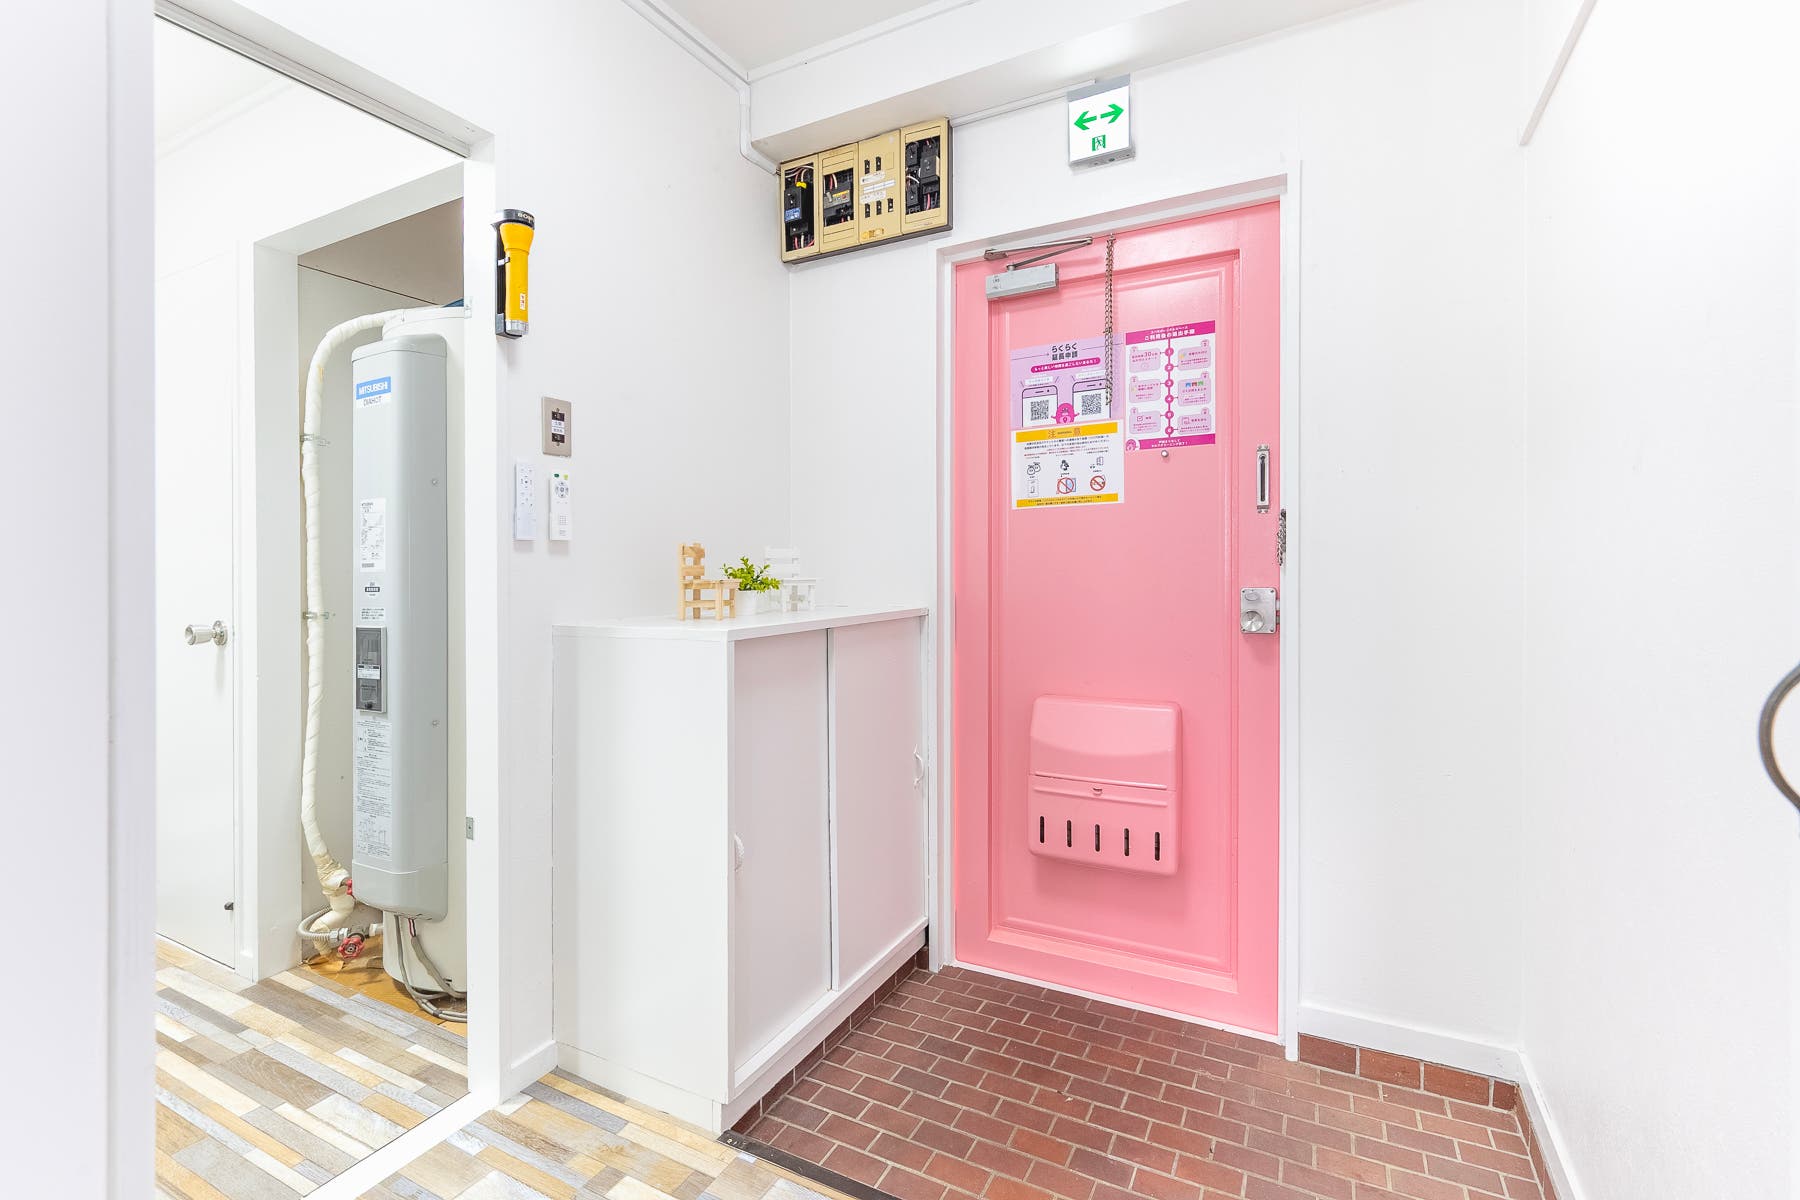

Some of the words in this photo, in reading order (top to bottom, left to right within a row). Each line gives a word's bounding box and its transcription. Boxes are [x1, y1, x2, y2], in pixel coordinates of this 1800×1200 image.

[1051, 342, 1078, 353] らくらく
[1051, 351, 1078, 361] 延長申請
[358, 381, 388, 396] MITSUBISHI
